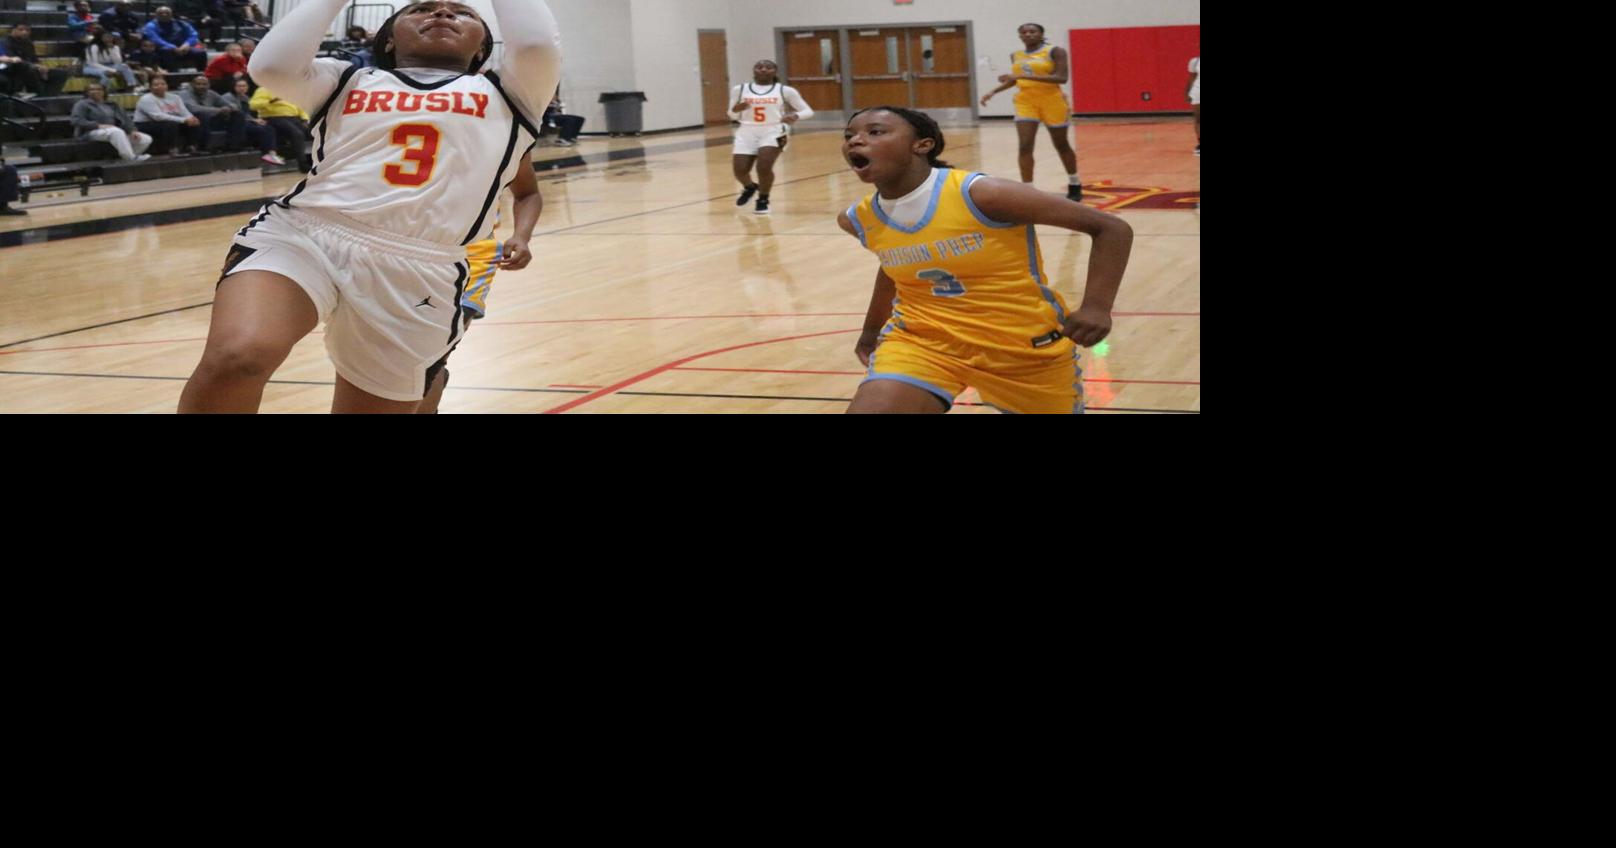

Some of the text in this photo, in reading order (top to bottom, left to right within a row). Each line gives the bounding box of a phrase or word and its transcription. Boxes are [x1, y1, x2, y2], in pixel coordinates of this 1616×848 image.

[342, 89, 489, 119] BRUSLY
[753, 106, 766, 123] 5
[382, 121, 443, 188] 3
[935, 232, 984, 261] PREP
[916, 267, 967, 297] 3
